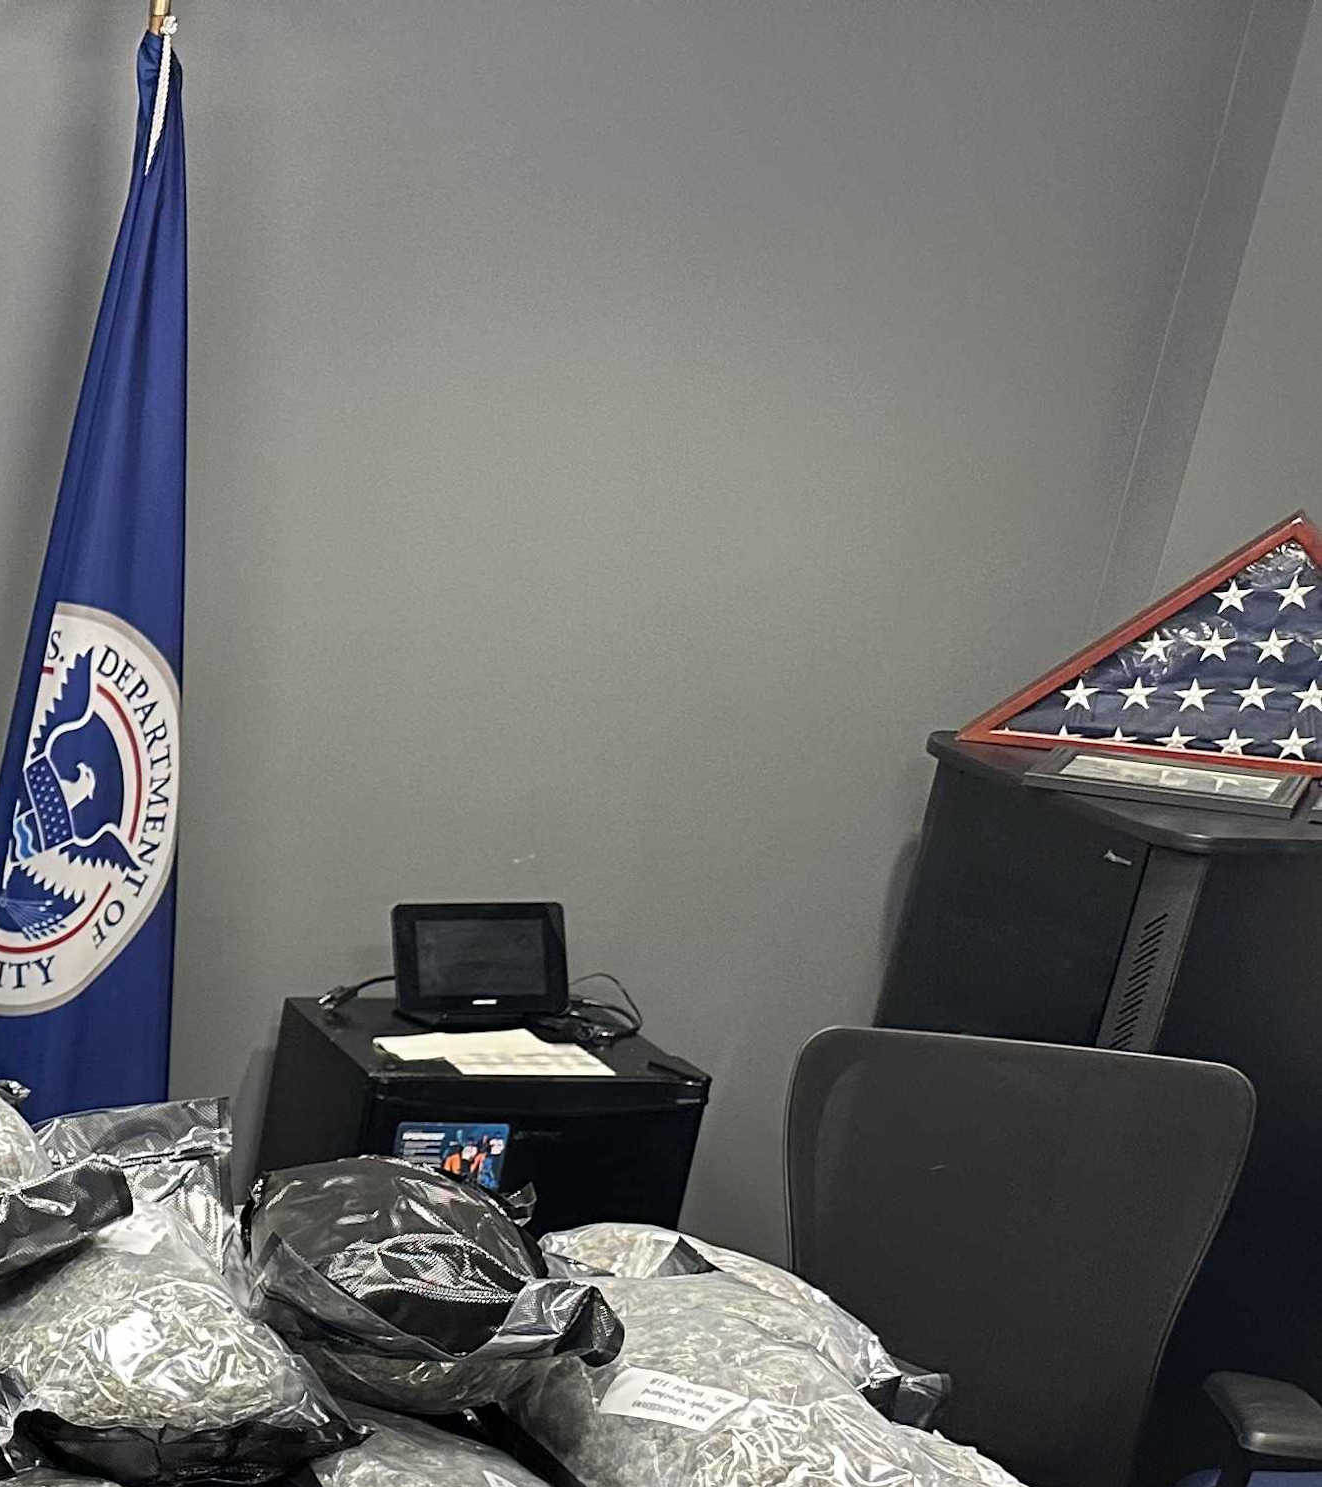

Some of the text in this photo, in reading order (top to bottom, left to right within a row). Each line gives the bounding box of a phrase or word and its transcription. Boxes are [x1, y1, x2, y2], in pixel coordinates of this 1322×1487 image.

[47, 630, 171, 949] S. DEPARTMENT OF
